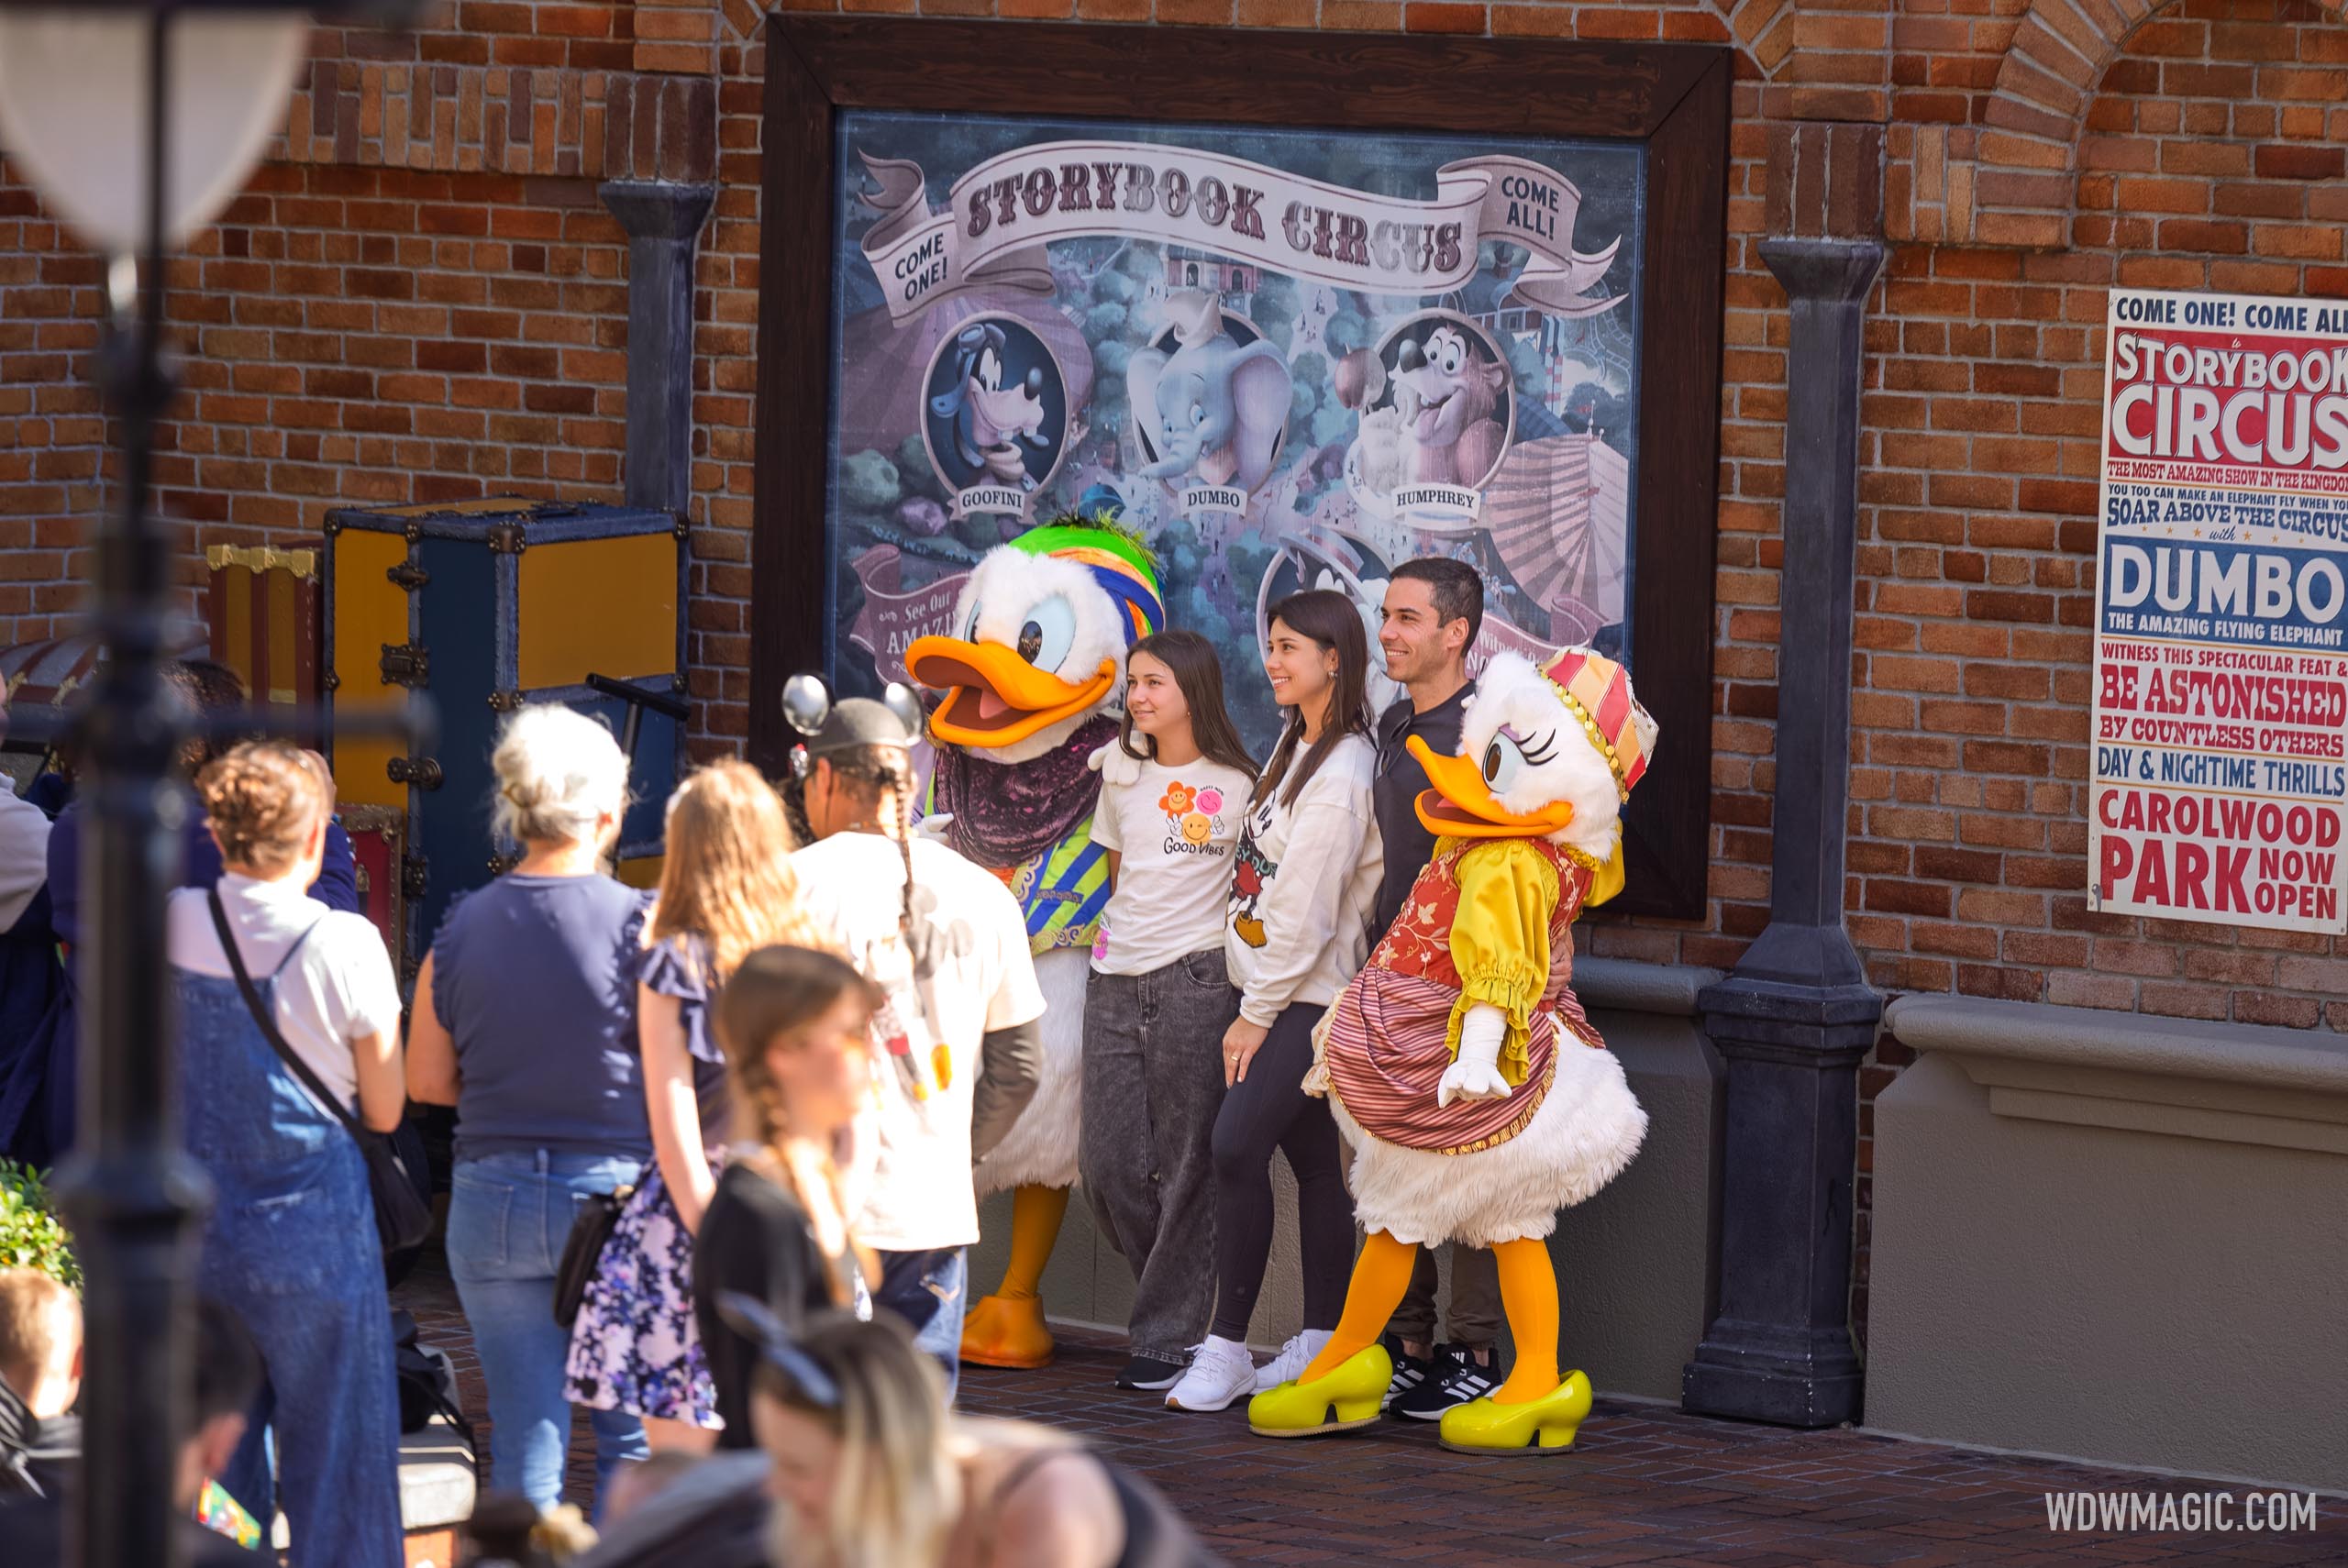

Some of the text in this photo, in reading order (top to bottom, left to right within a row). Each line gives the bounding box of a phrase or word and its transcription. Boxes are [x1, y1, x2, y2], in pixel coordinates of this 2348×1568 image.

[1501, 175, 1559, 214] COME
[968, 161, 1462, 274] STORYBOOK CIRCUS
[1506, 201, 1556, 241] ALL!
[895, 233, 944, 280] COME
[904, 258, 947, 302] ONE!
[2117, 298, 2176, 323] COME
[2185, 302, 2235, 326] ONE!
[2245, 304, 2307, 331] COME
[2115, 331, 2348, 394] STORYBOOK
[2111, 381, 2348, 470] CIRCUS
[2107, 460, 2348, 492] THE MOST AMAZING SHOW IN THE KINGDO
[962, 491, 1022, 508] GOOFINI
[1188, 491, 1240, 508] DUMBO
[1397, 488, 1475, 510] HUMPHREY
[2107, 497, 2160, 527] SOAR
[2164, 502, 2231, 523] ABOVE
[2234, 506, 2275, 527] THE
[2109, 483, 2348, 511] YOU TOO CAN MAKE AN ELEPHANT FLY WHEN YO
[2209, 525, 2236, 542] with
[2109, 543, 2345, 624] DUMBO
[905, 591, 951, 623] See Our
[2109, 613, 2343, 646] THE AMAZING FLYING ELEPHANT
[2101, 643, 2348, 677] WITNESS THIS SPECTACULAR FEAT &
[2099, 664, 2347, 727] BE ASTONISHED
[2100, 715, 2344, 757] BY COUNTLESS OTHERS
[2098, 746, 2345, 797] DAY & NIGHTIME THRILLS
[2099, 790, 2341, 847] CAROLWOOD
[2100, 834, 2253, 914] PARK
[2259, 847, 2337, 886] NOW
[2254, 881, 2337, 920] OPEN
